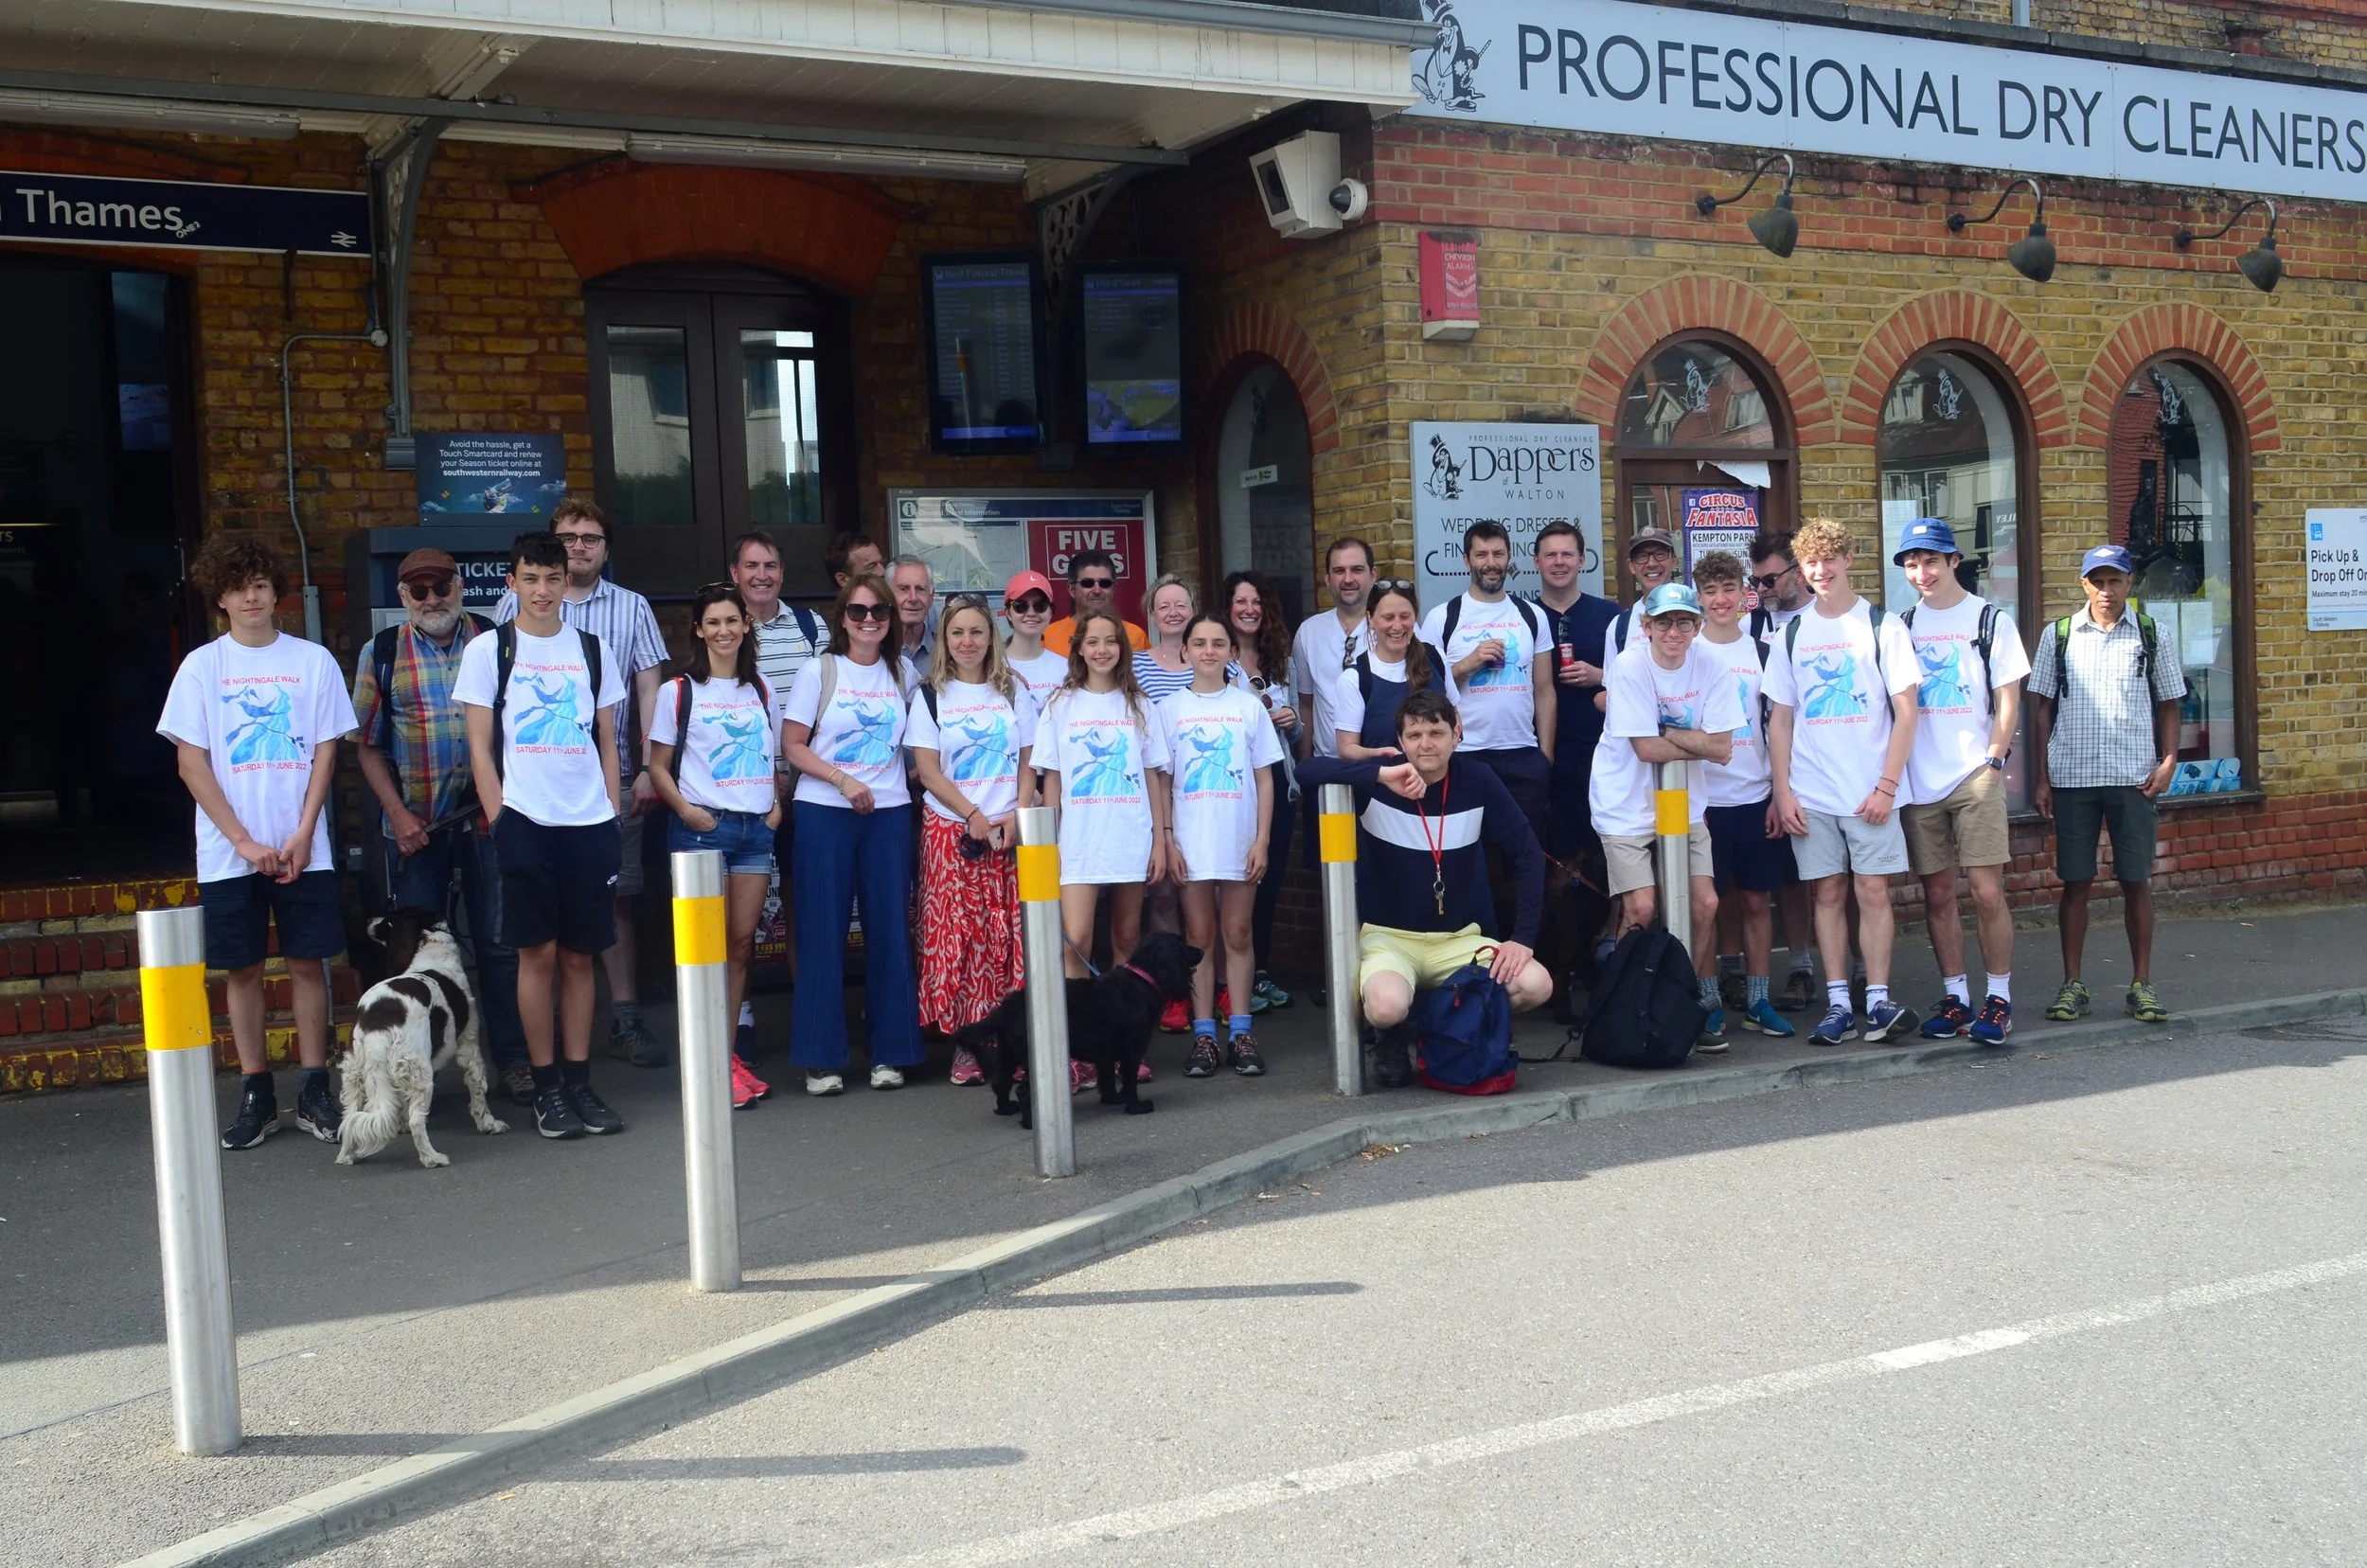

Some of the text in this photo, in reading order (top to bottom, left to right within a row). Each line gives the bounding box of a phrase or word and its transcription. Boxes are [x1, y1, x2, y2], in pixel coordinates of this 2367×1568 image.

[1518, 24, 2366, 174] PROFESSIONAL DRY CLEANERS
[16, 188, 184, 231] Thames
[1444, 253, 1476, 262] CHEVRON
[450, 440, 471, 449] Avoid
[472, 440, 485, 449] the
[486, 440, 512, 450] hassle,
[512, 441, 525, 451] get
[439, 449, 463, 457] Touch
[463, 450, 503, 458] Smartcard
[504, 450, 519, 458] and
[488, 459, 509, 468] ticket
[1468, 445, 1595, 485] Dappers
[442, 469, 541, 478] southwesternrailway.com
[1504, 489, 1565, 500] WALTON
[1699, 492, 1746, 508] CIRCUS
[1685, 508, 1759, 527] FANTASIA
[1059, 530, 1116, 550] FIVE
[1692, 533, 1733, 543] KEMPTON
[1052, 553, 1125, 575] GS
[2311, 549, 2358, 565] Pick Up &
[2311, 569, 2336, 585] Drop
[2339, 568, 2355, 581] Off
[232, 675, 280, 686] NIGHTINGALE
[280, 675, 301, 685] WALK
[232, 763, 265, 775] SATURDAY
